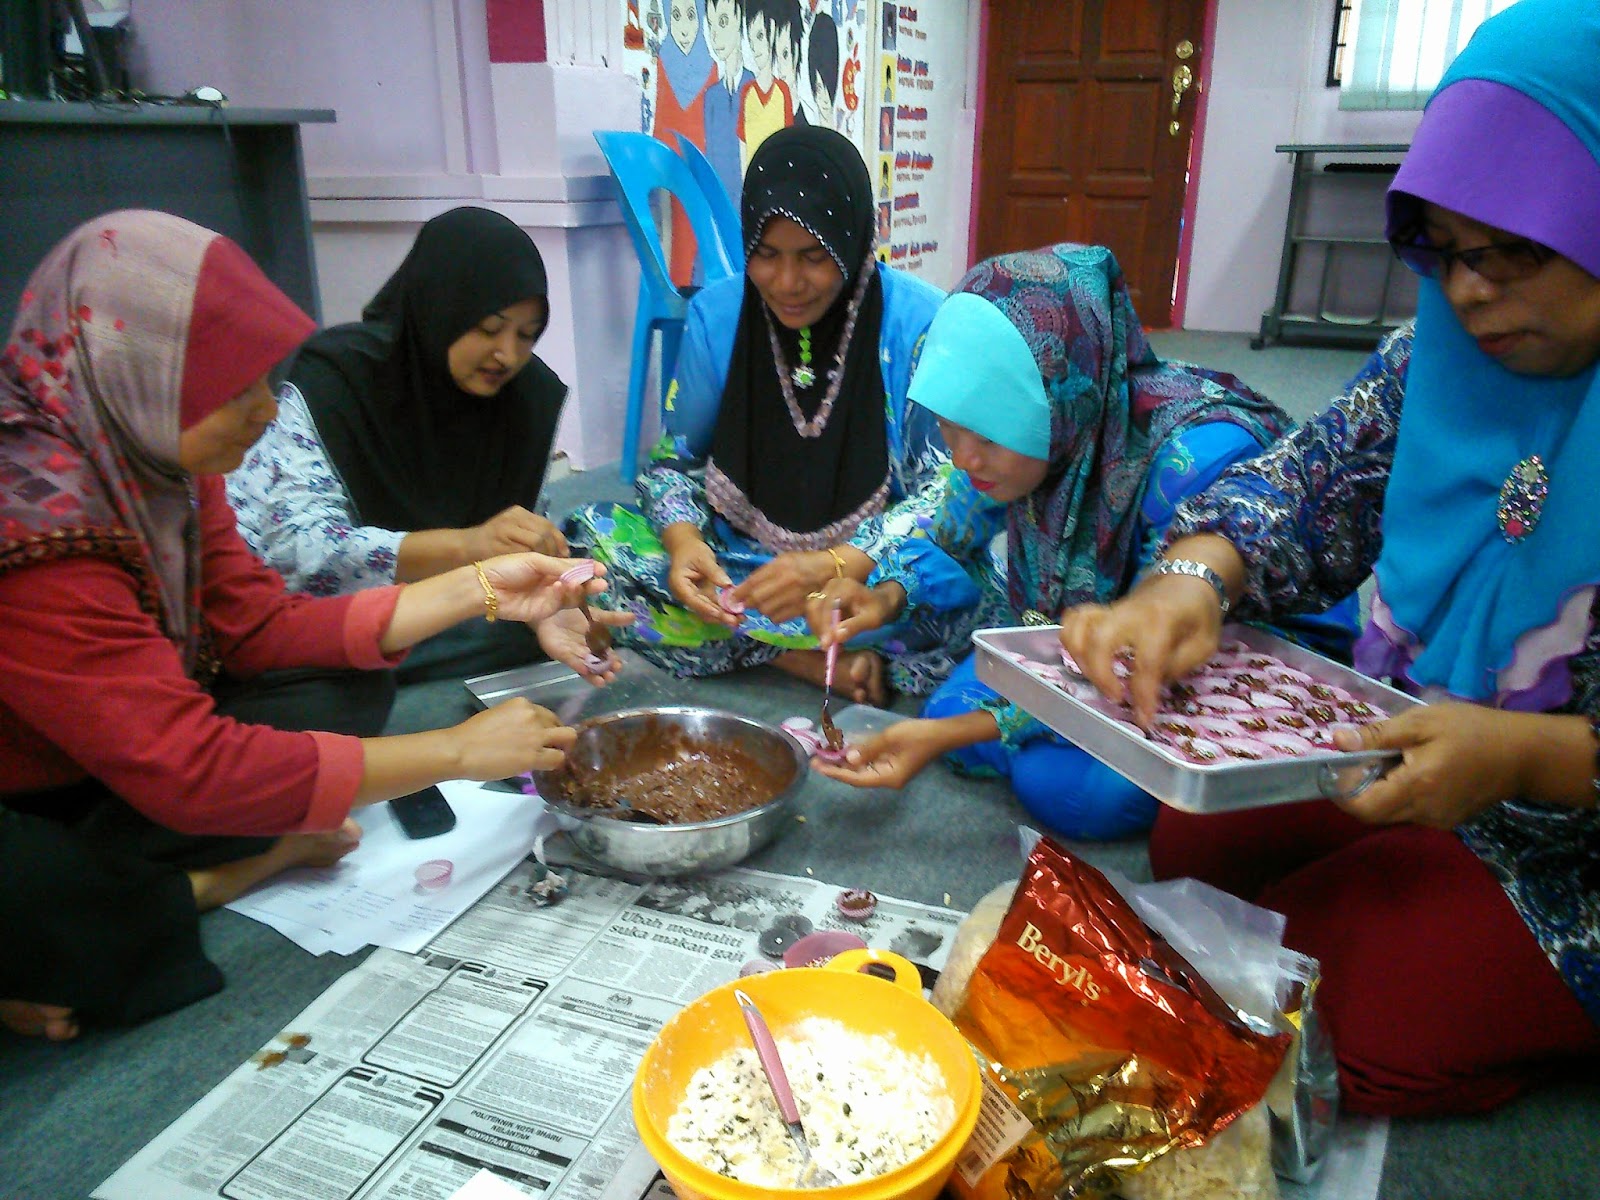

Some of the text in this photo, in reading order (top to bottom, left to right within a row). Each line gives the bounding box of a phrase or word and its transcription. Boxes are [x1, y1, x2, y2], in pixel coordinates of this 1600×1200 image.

[608, 924, 746, 963] suka makan gaji
[620, 910, 745, 948] Ubah mentaliti
[1016, 920, 1101, 1001] Beryl's
